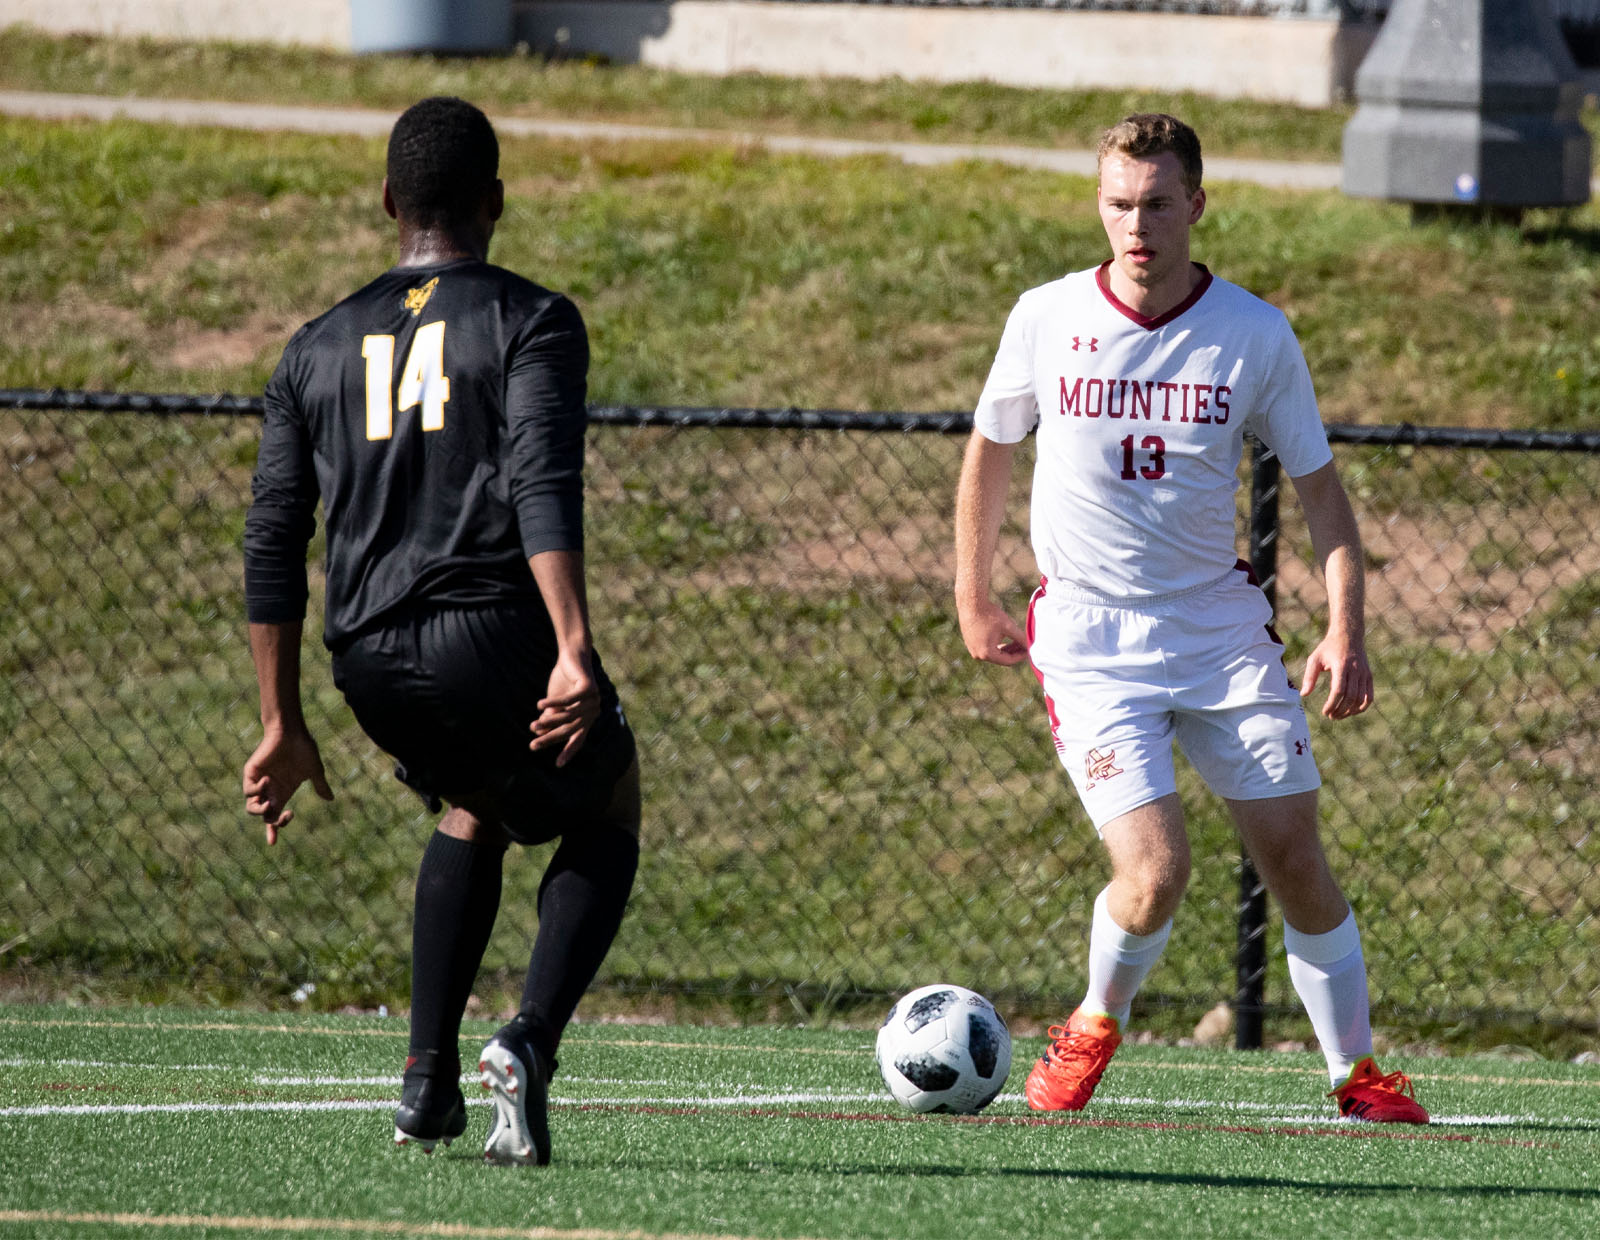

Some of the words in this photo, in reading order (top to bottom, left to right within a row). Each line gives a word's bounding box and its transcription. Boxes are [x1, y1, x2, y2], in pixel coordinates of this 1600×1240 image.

[361, 320, 450, 441] 14
[1059, 376, 1232, 425] MOUNTIES
[1120, 434, 1166, 480] 13
